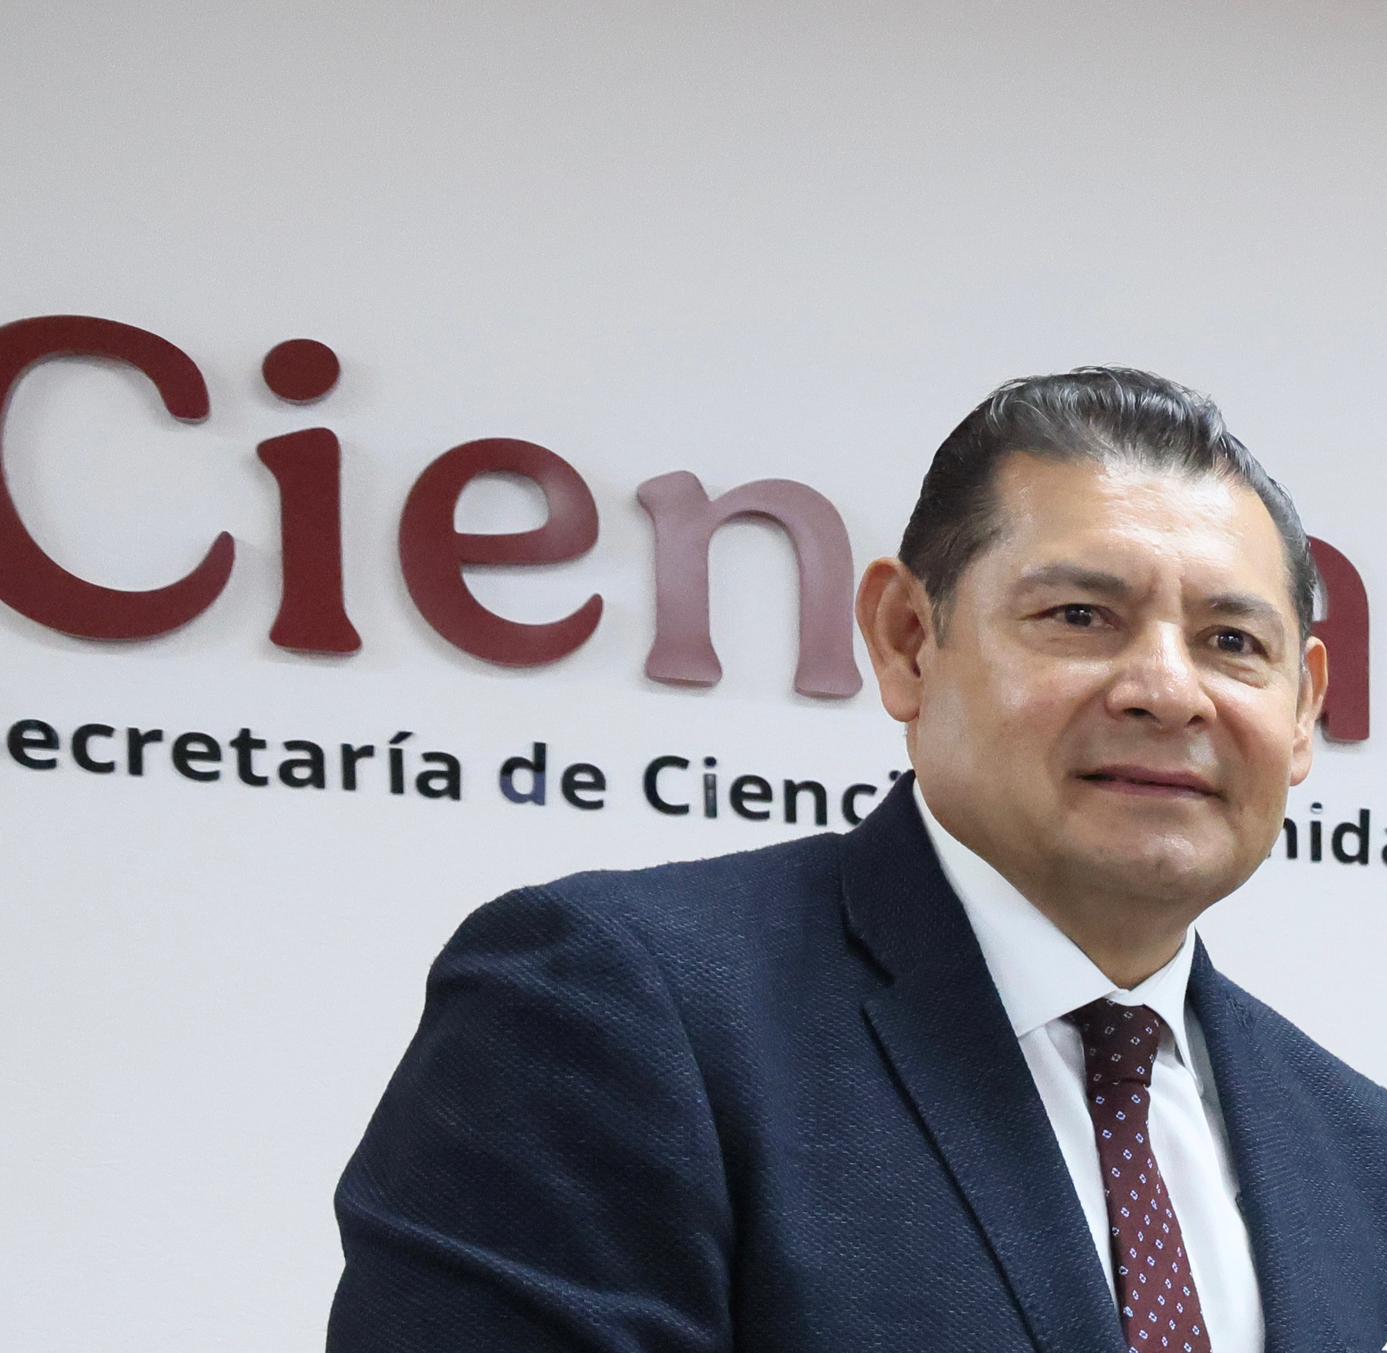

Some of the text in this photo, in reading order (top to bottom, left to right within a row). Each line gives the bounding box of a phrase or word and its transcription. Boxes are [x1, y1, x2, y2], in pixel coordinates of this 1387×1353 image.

[6, 716, 462, 801] ecretaría
[499, 741, 606, 810] de
[643, 754, 902, 827] Cienc
